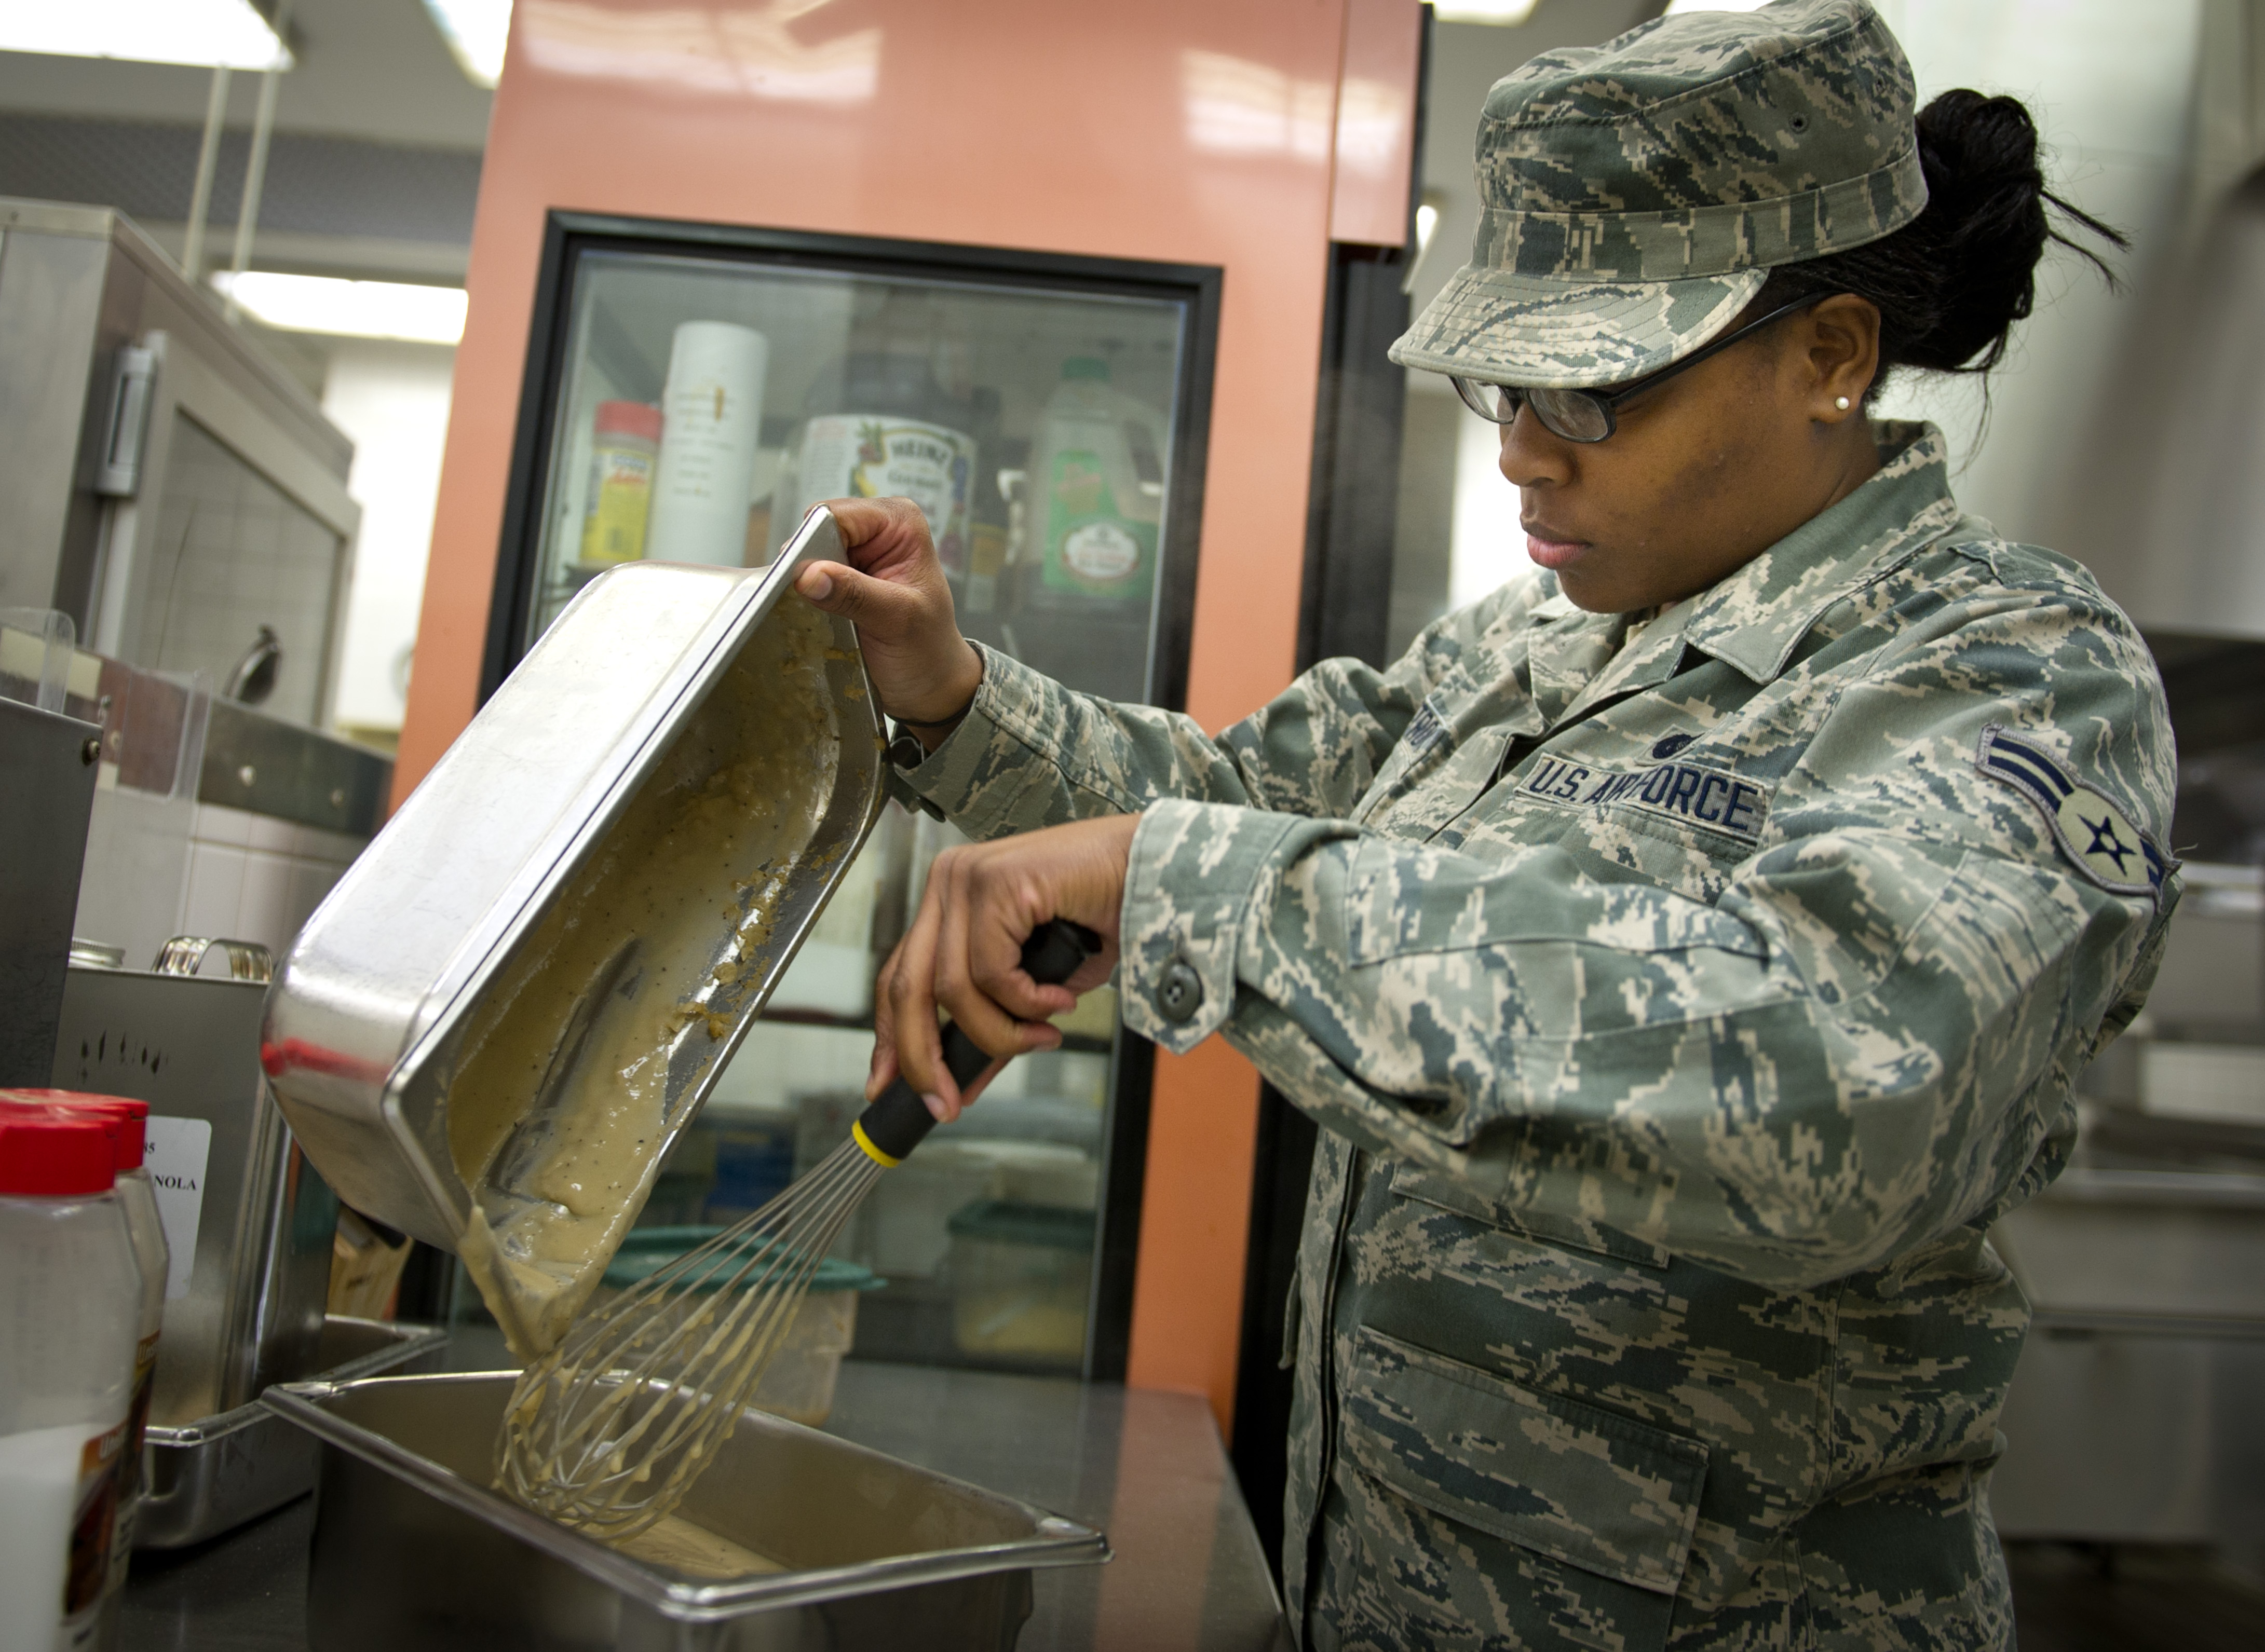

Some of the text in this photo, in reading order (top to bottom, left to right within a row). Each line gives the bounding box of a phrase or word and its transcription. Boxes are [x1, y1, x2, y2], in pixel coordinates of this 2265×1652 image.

[890, 440, 948, 466] HEINZ
[1529, 761, 1758, 831] U.S. AIR FORCE
[155, 1175, 196, 1191] NOLA
